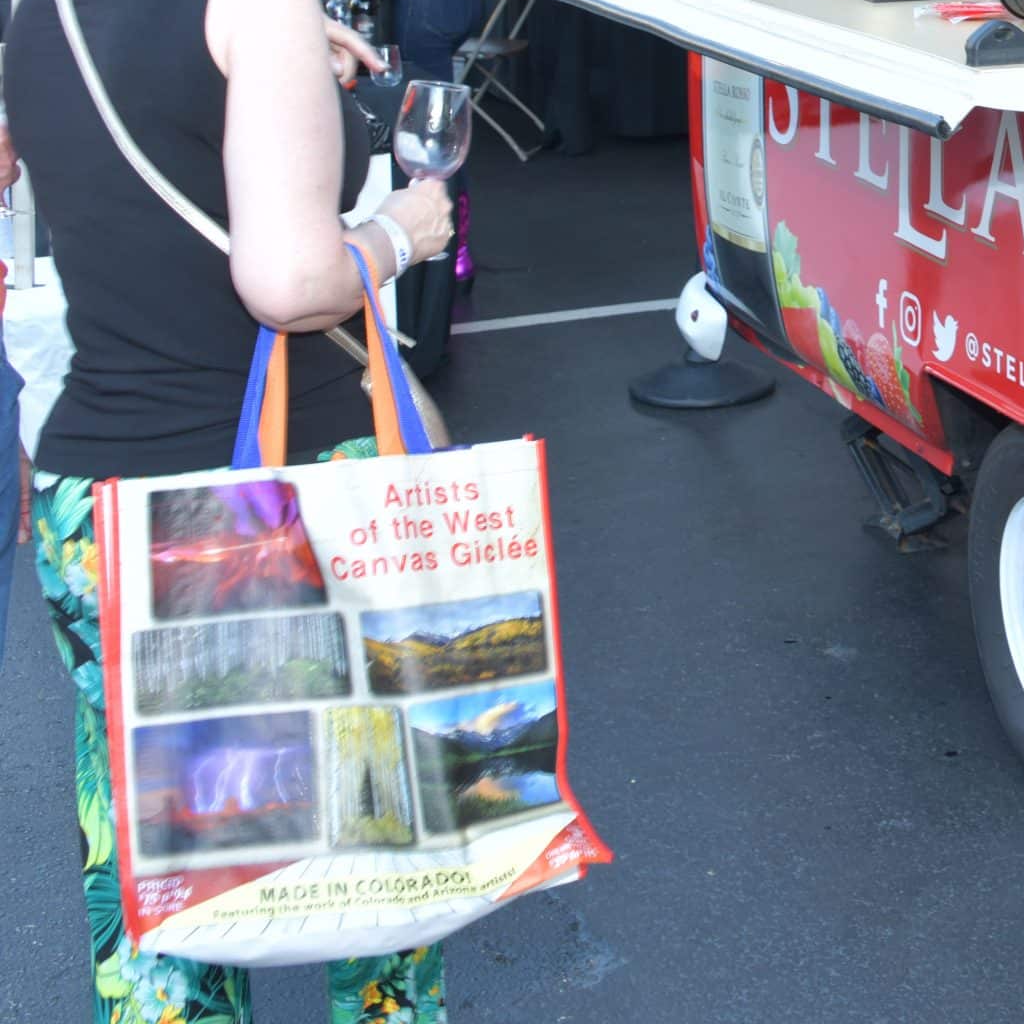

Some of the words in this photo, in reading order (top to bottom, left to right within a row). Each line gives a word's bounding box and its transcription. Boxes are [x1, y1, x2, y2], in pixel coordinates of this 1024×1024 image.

[384, 480, 481, 508] Artists
[351, 519, 379, 546] of
[392, 515, 434, 541] the
[443, 505, 516, 536] West
[330, 550, 439, 581] Canvas
[450, 533, 539, 567] Giclée
[260, 883, 319, 904] MADE
[328, 882, 348, 897] IN
[355, 869, 472, 895] COLORADO!
